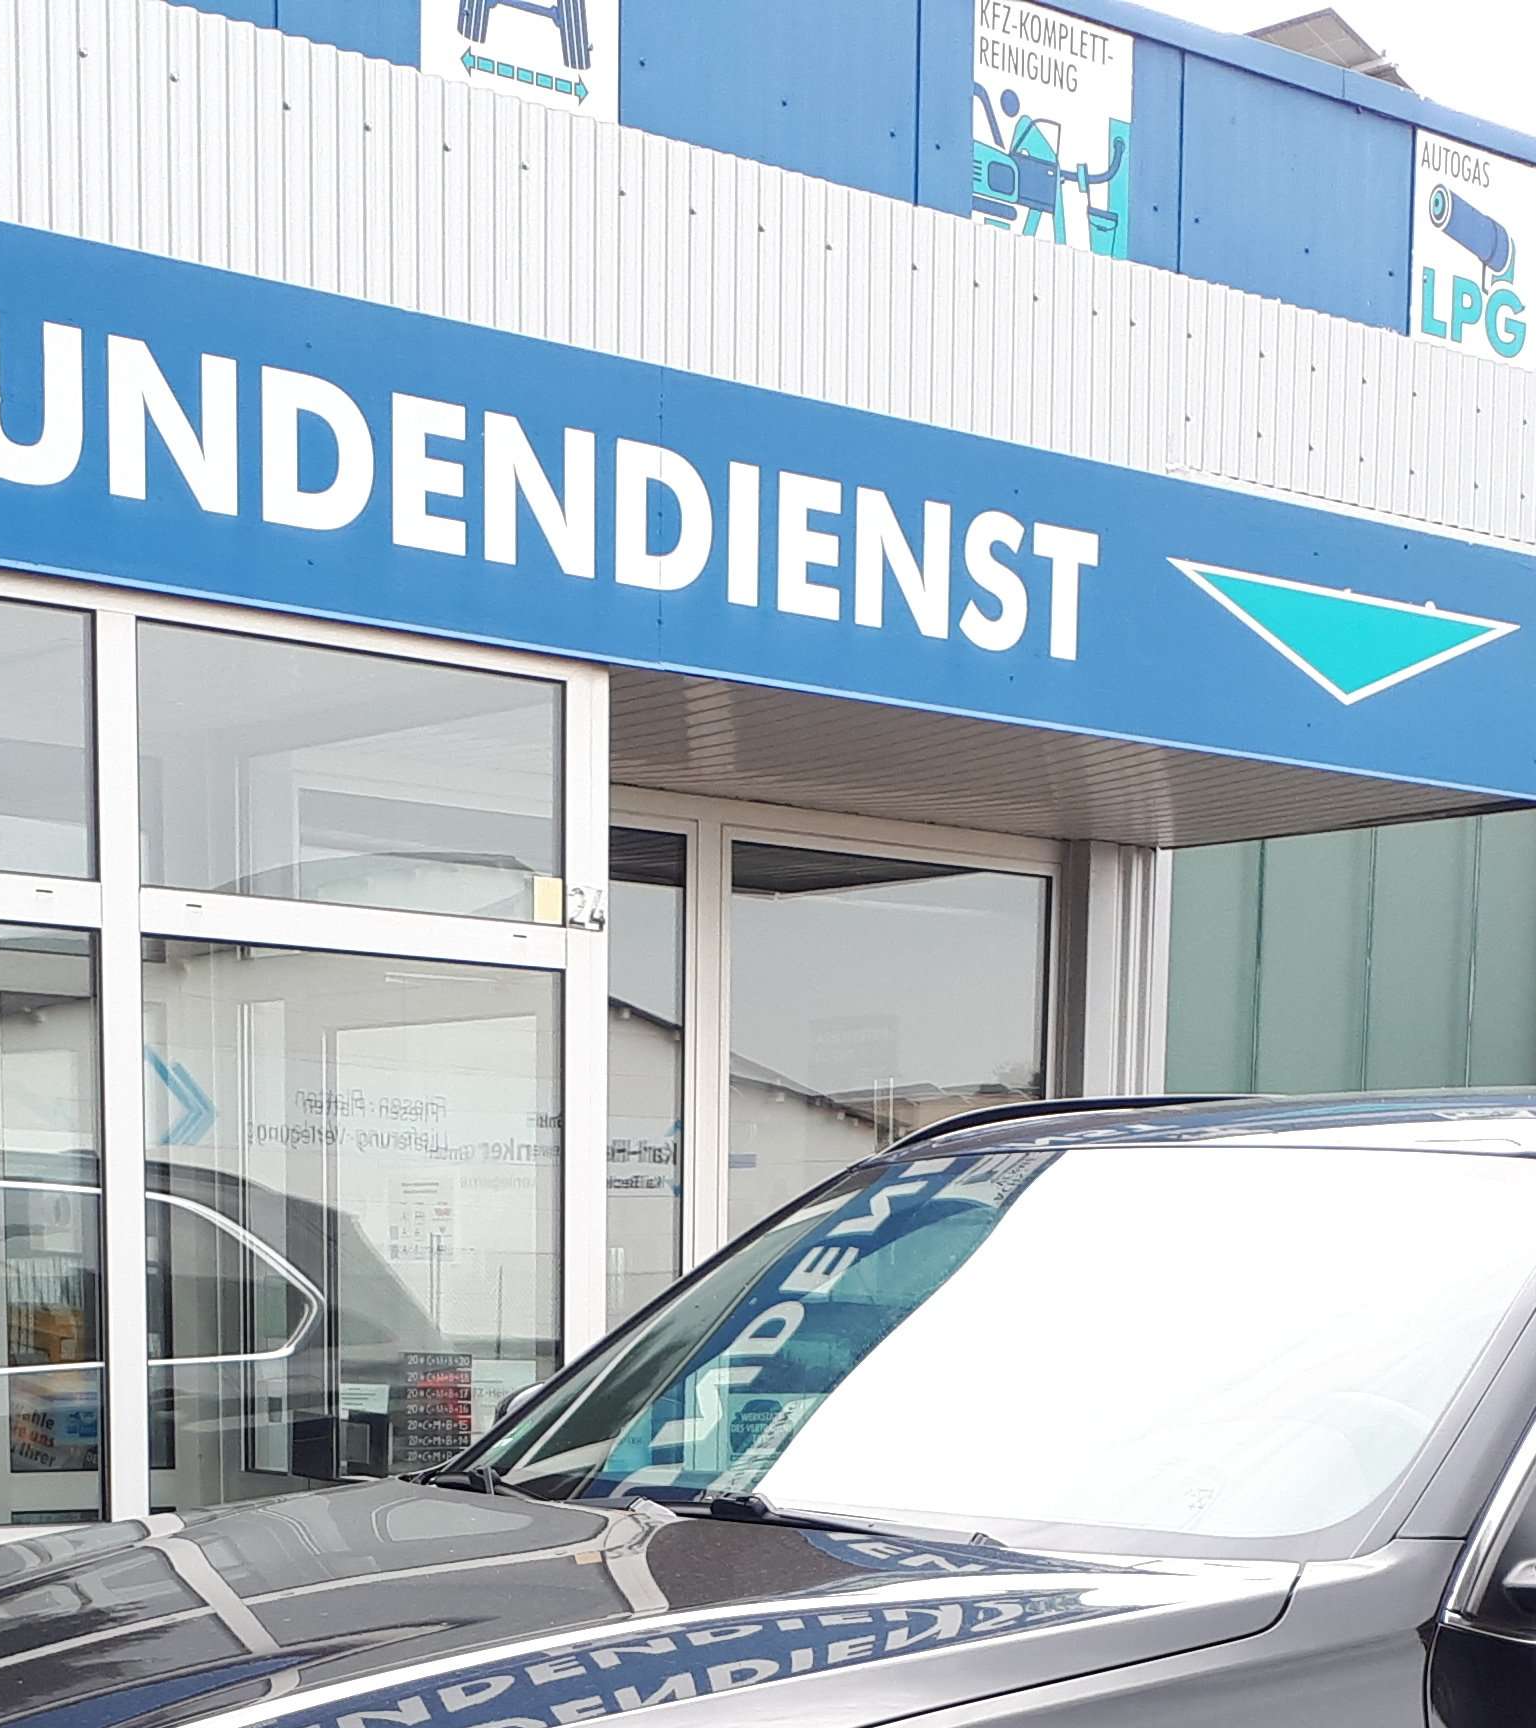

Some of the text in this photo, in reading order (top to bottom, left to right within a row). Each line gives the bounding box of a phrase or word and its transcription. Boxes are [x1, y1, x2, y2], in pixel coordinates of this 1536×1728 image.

[980, 0, 1114, 65] KFZ-KOMPLETT-
[979, 36, 1078, 92] REINIGUNG
[1421, 141, 1490, 188] AUTOGAS
[1421, 266, 1527, 358] LPG
